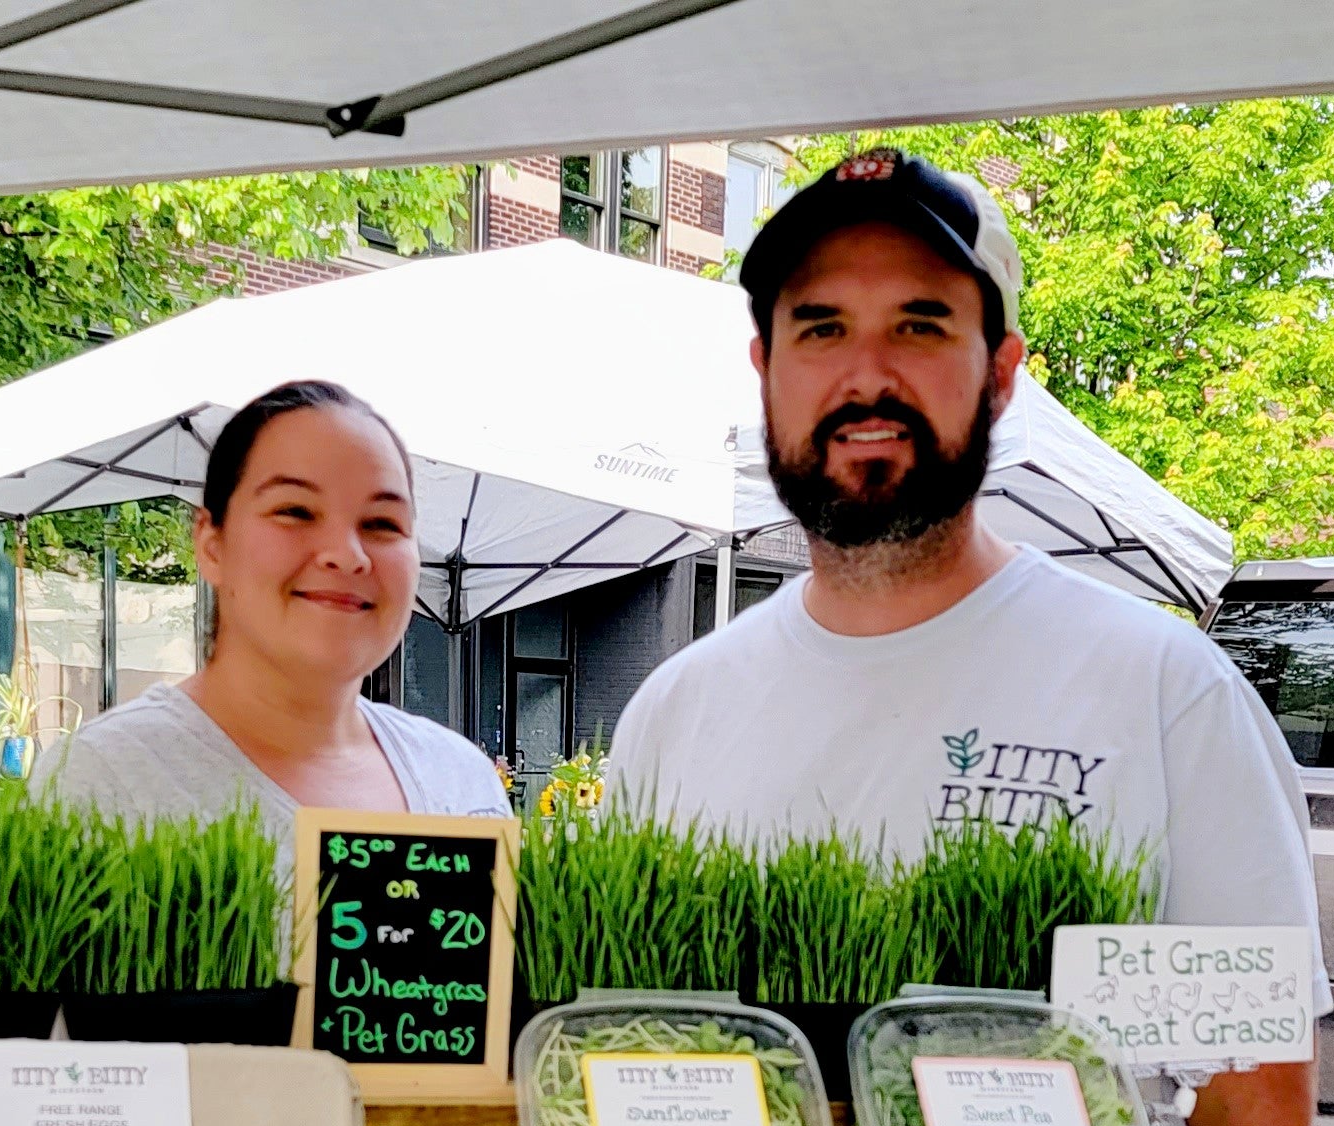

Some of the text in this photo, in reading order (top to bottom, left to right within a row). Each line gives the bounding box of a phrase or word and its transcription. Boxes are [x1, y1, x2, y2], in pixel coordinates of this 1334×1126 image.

[594, 454, 680, 483] SUNTIME
[984, 743, 1106, 796] ITTY
[330, 901, 367, 950] 5
[428, 908, 486, 949] $20
[1097, 937, 1274, 976] Pet Grass
[328, 957, 487, 1016] Wheatgrass
[336, 1005, 388, 1054] Pet
[396, 1012, 475, 1056] Grass
[1098, 1006, 1306, 1048] heat Grass)
[626, 1104, 732, 1122] Sunflower
